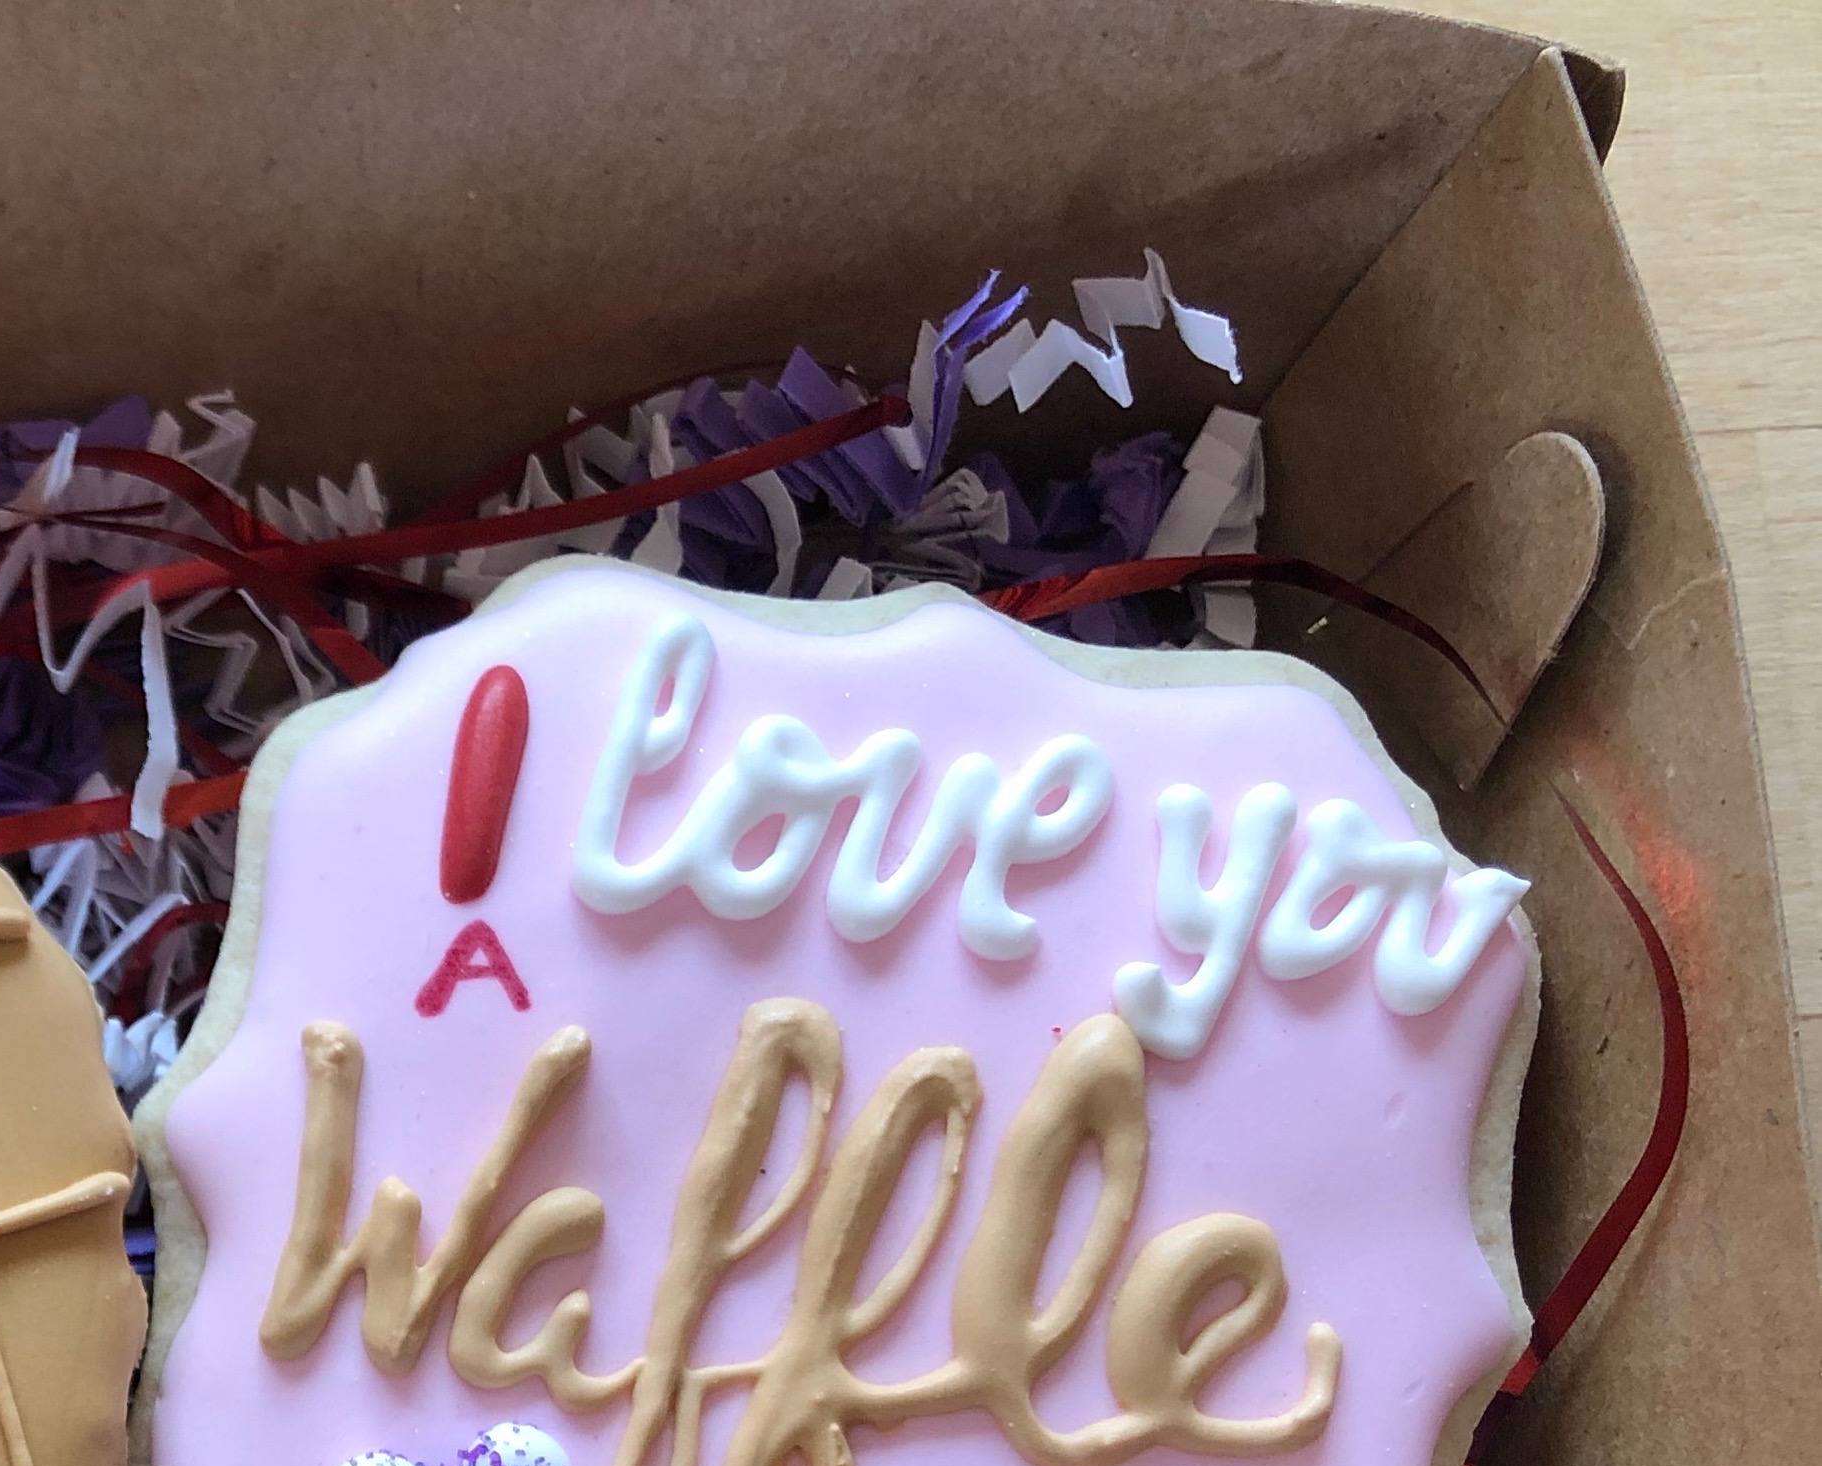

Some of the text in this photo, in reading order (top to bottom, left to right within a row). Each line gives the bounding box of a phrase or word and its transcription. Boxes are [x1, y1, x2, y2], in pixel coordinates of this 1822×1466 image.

[414, 919, 532, 1019] A
[439, 612, 1532, 1061] I love you
